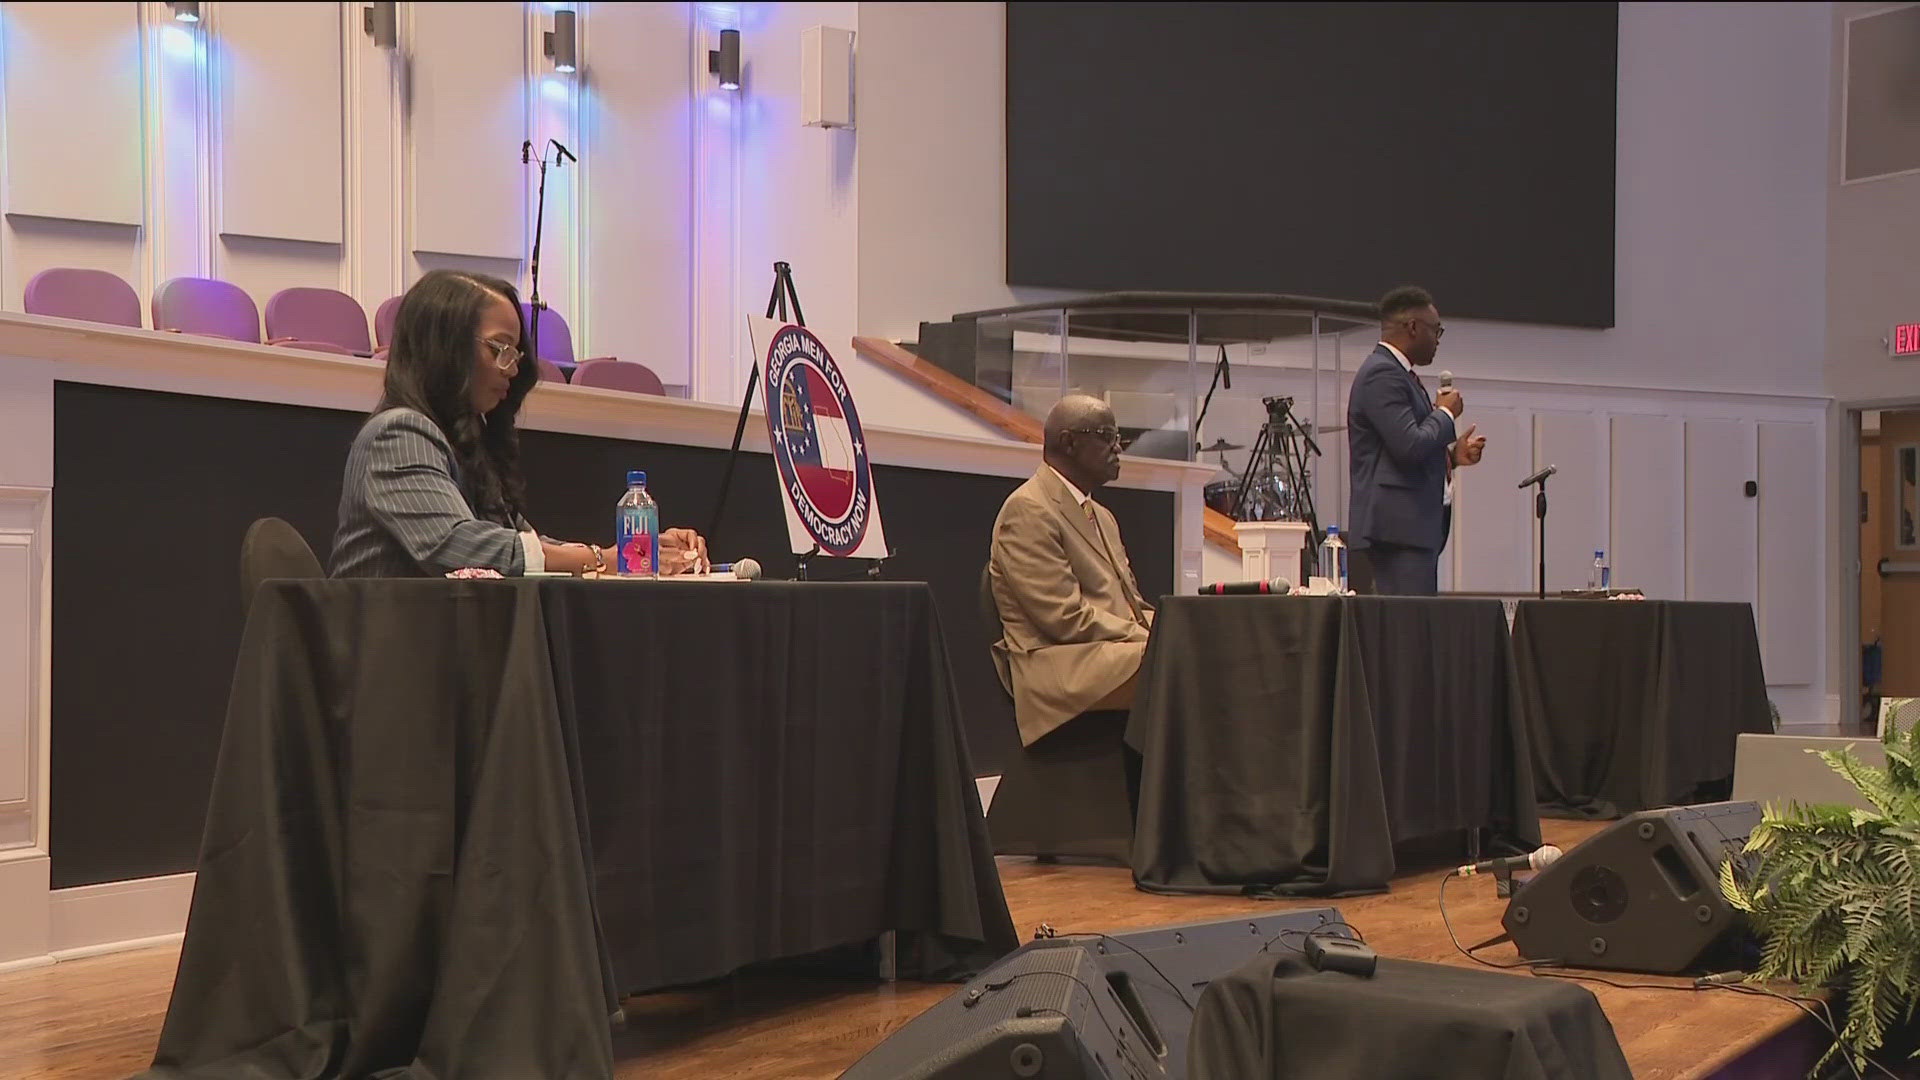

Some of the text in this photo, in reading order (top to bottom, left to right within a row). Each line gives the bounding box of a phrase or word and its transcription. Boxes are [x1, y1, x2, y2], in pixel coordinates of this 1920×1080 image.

[1897, 324, 1920, 353] EXI
[769, 334, 847, 402] GEORGIA MEN FOR
[624, 515, 649, 535] FIJI
[791, 482, 867, 546] DEMOCRACY NOW
